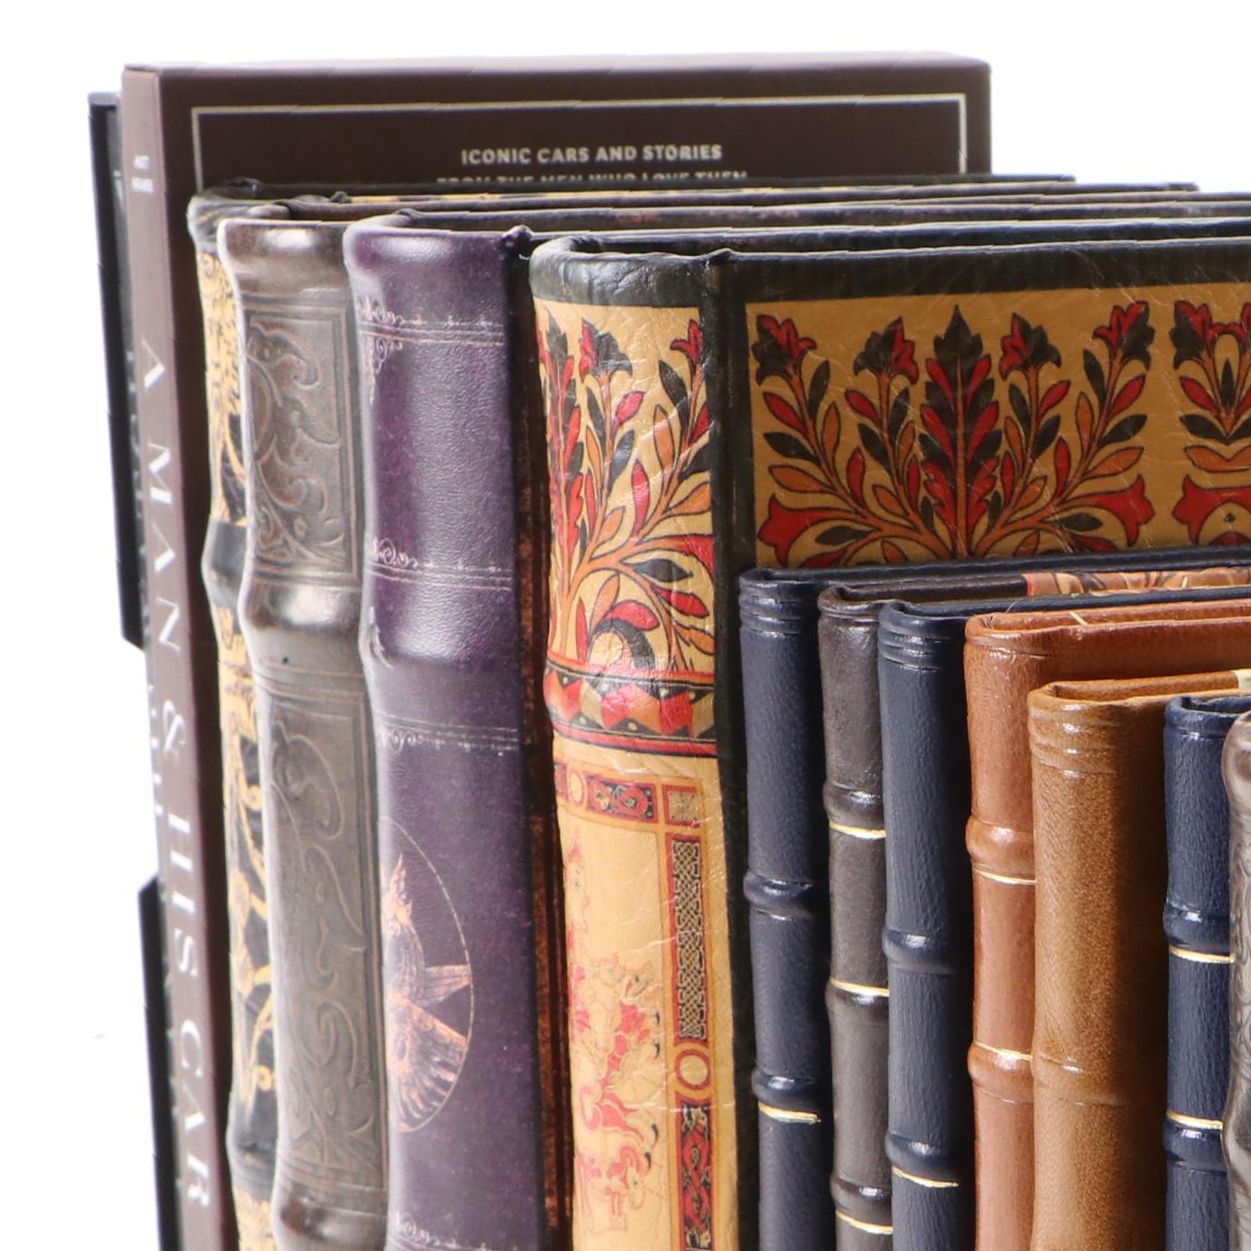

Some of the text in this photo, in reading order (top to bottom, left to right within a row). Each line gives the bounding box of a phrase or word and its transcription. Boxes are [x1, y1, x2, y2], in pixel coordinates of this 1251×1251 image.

[461, 144, 723, 165] ICONIC CARS AND STORIES
[141, 338, 165, 391] A
[147, 437, 182, 655] MAN
[162, 698, 187, 765] &
[167, 811, 199, 979] HIS
[178, 1018, 211, 1209] CAR
